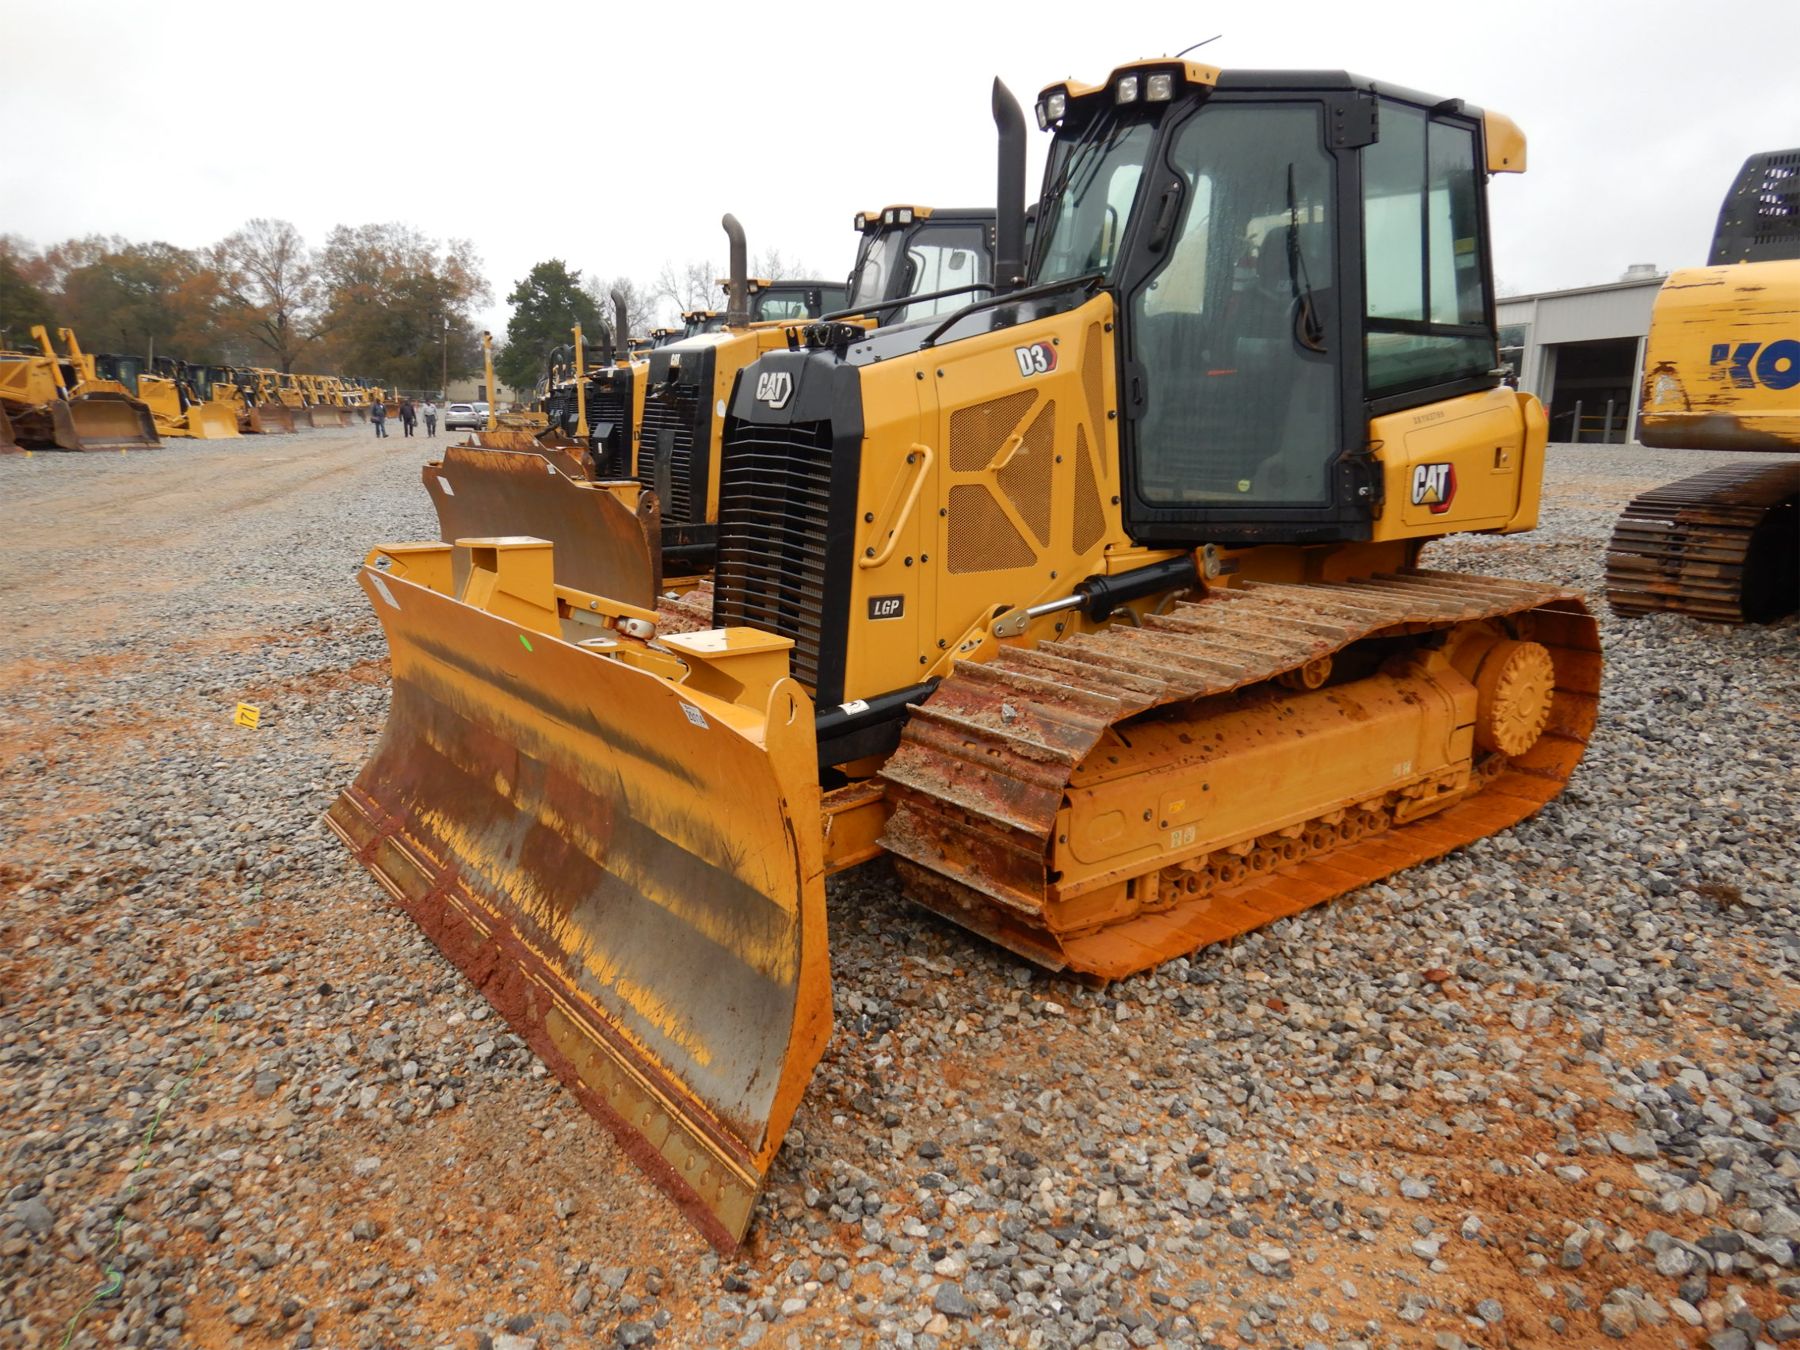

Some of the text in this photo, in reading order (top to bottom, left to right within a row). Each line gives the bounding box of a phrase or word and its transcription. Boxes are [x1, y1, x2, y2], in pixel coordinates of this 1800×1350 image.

[1015, 344, 1048, 376] D3
[756, 372, 787, 400] CAT
[1411, 463, 1450, 505] CAT
[873, 599, 900, 616] LGP
[239, 707, 257, 728] 171
